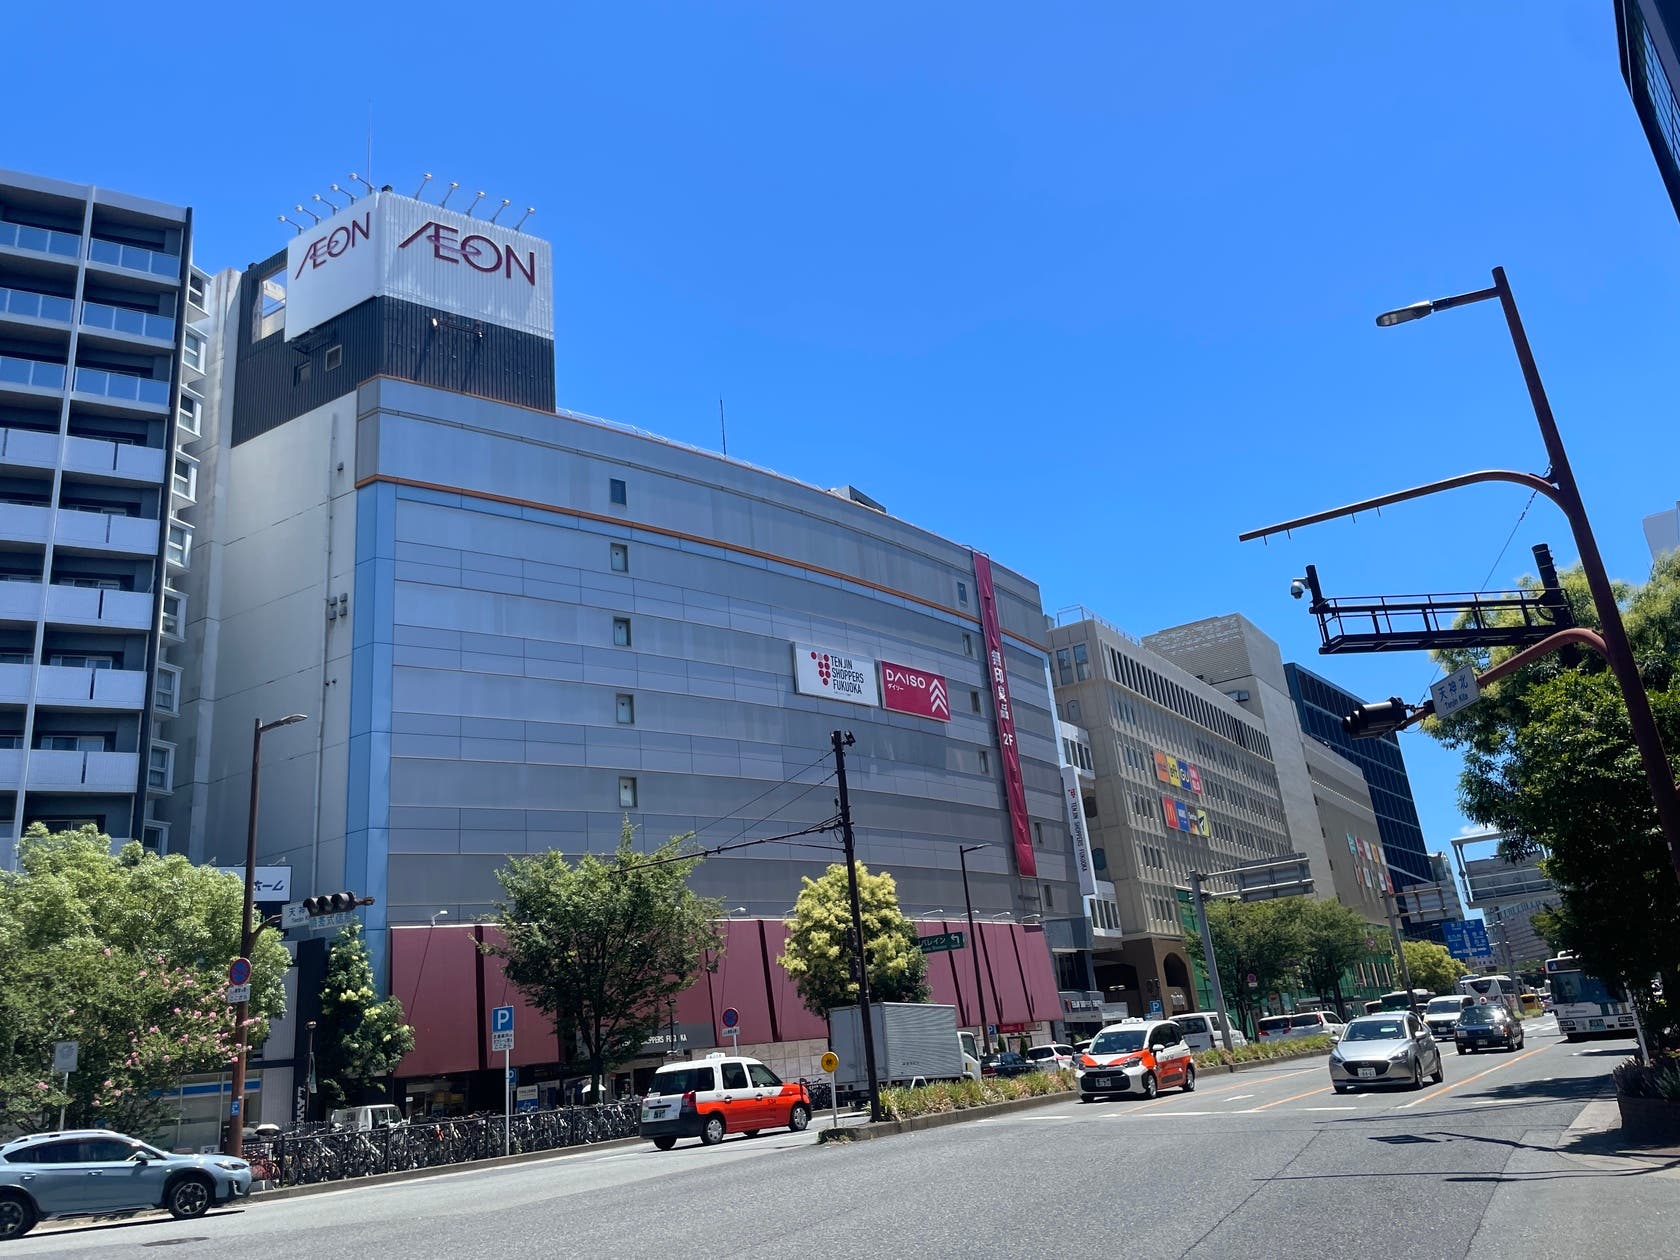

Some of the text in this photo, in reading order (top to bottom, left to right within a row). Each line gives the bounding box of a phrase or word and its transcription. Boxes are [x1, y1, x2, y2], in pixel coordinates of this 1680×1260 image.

[830, 655, 853, 670] TENJIN
[831, 667, 865, 684] SHOPPERS
[886, 669, 926, 689] DAISO
[832, 679, 863, 695] FUKUOKA
[1003, 732, 1014, 746] 2F
[497, 1009, 510, 1030] P
